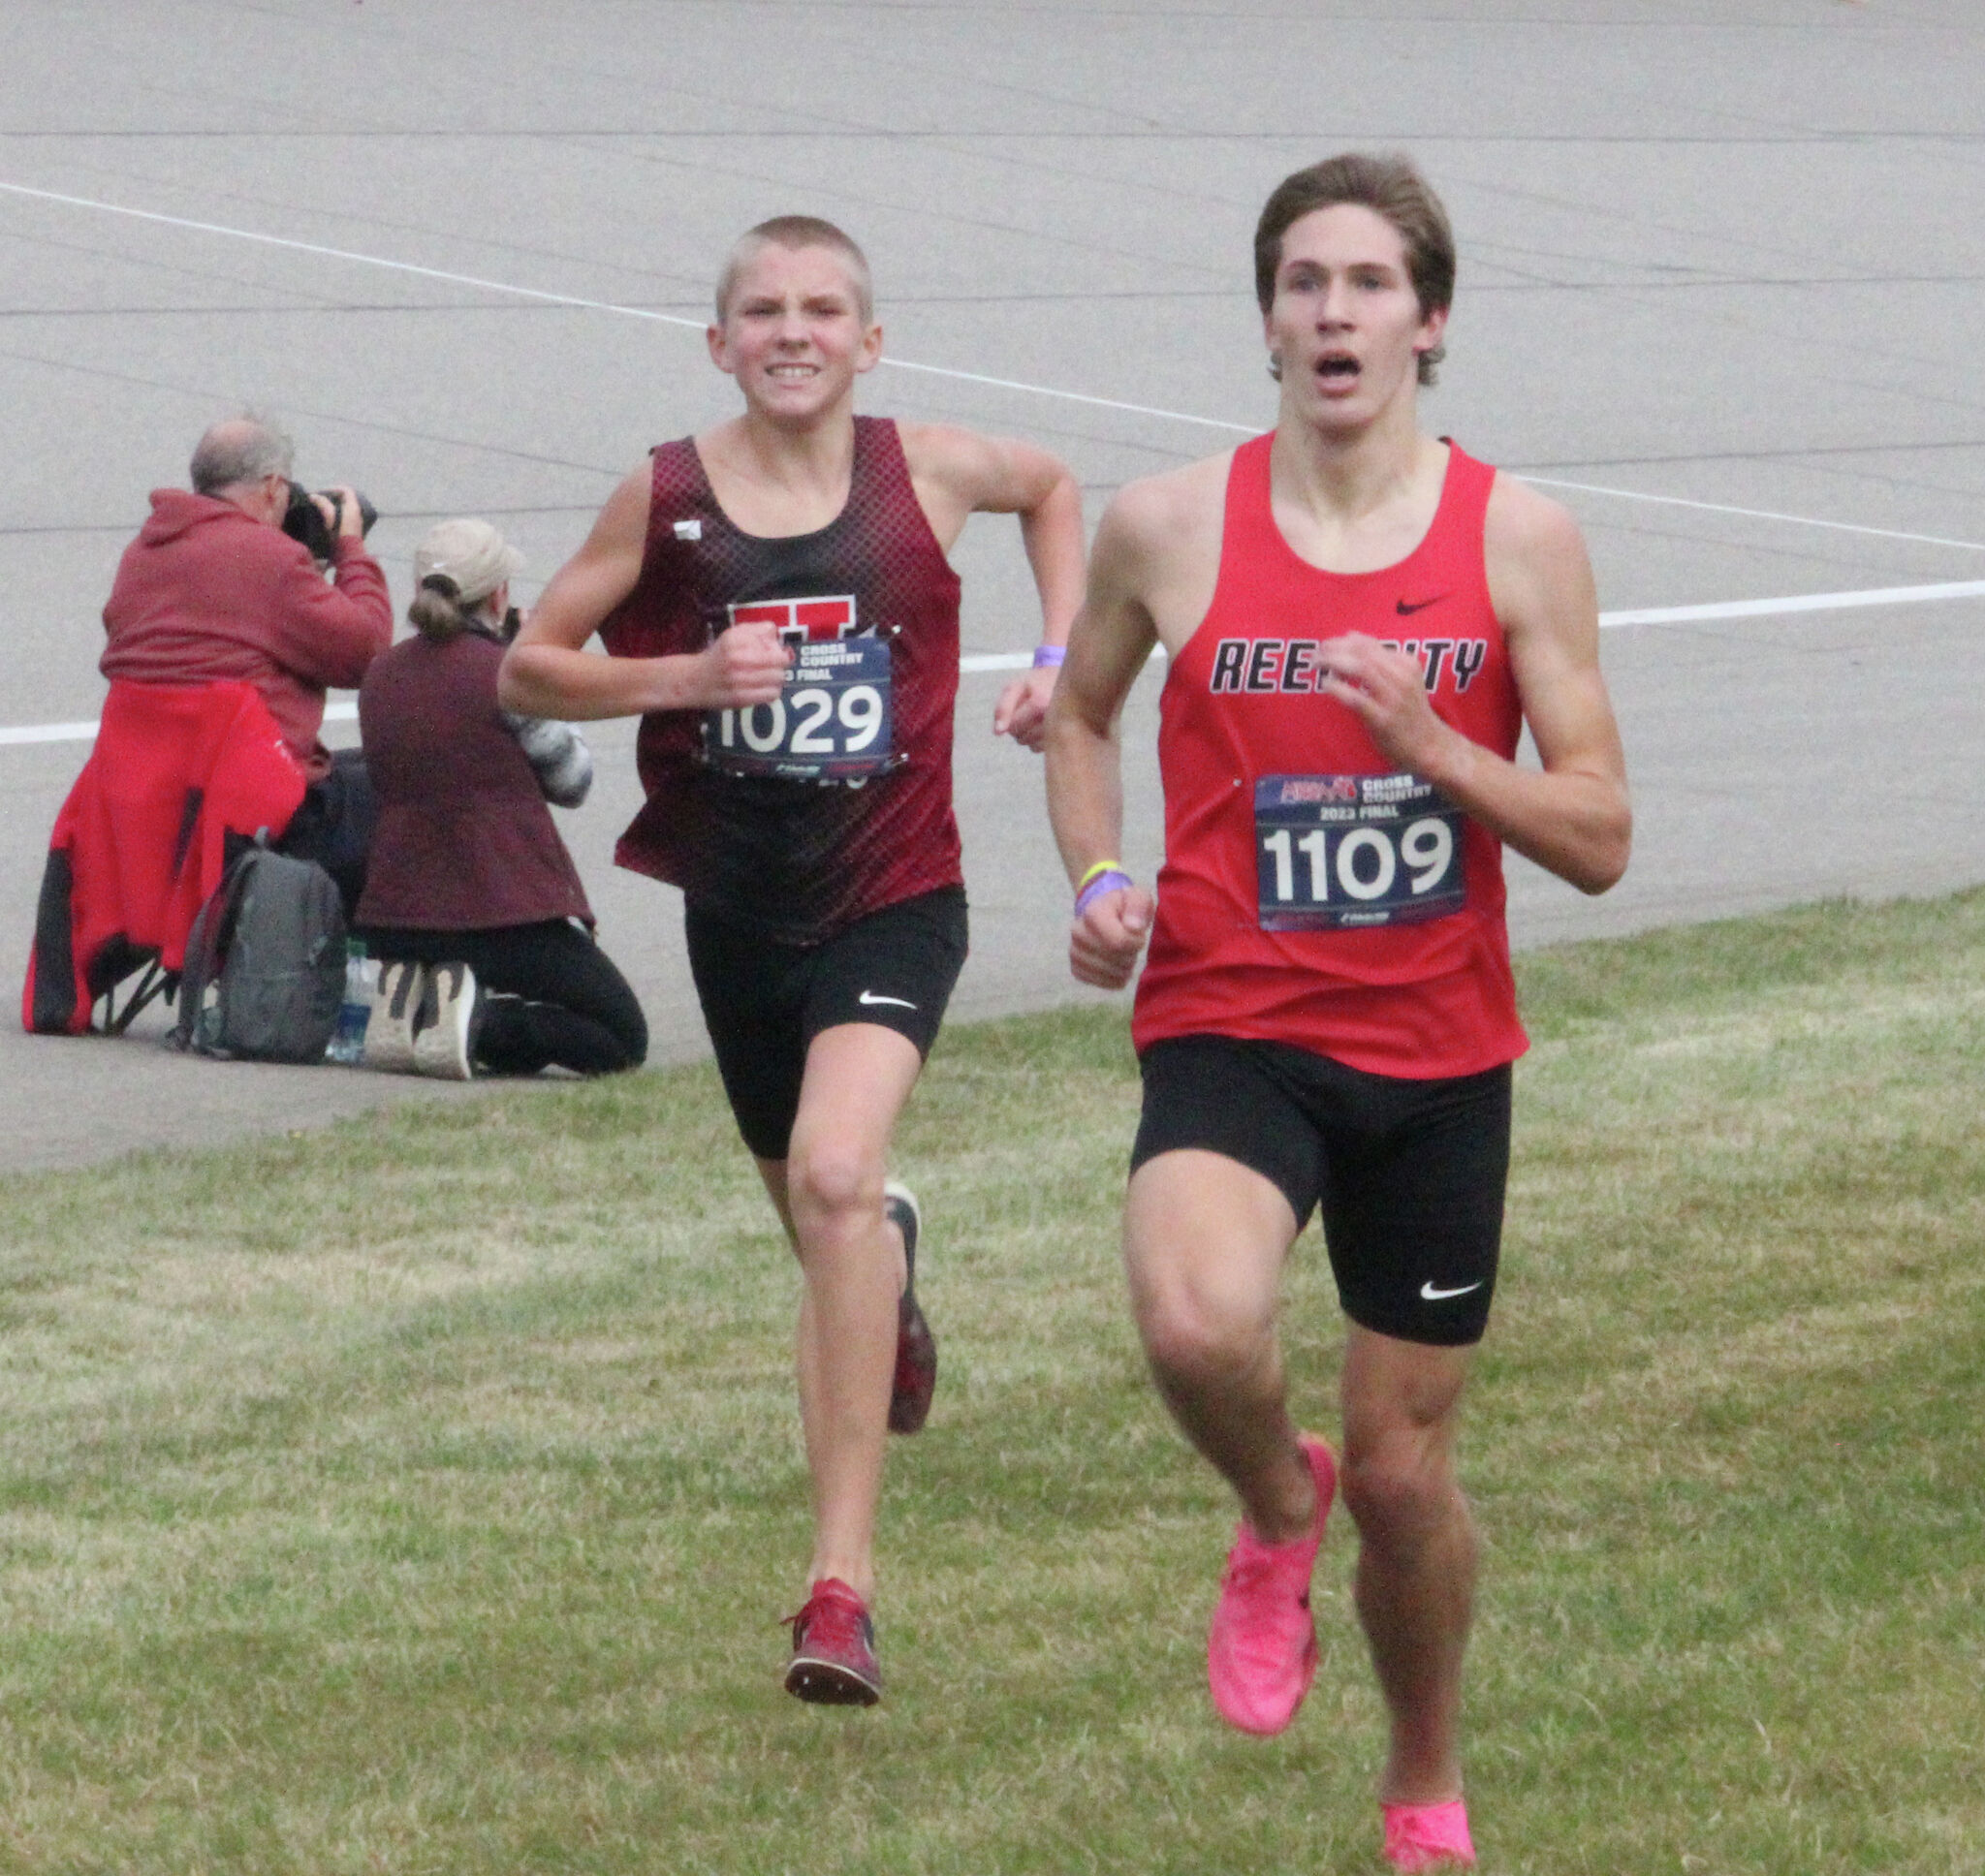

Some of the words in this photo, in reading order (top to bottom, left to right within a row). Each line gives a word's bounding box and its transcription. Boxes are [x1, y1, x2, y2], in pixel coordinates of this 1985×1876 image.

[800, 643, 847, 656] CROSS
[800, 652, 864, 667] COUNTRY
[1378, 638, 1487, 694] TY
[797, 668, 834, 681] FINAL
[721, 685, 883, 753] 1029
[1362, 775, 1413, 792] CROSS
[1362, 784, 1433, 804] COUNTRY
[1320, 806, 1356, 821] 2023
[1359, 804, 1400, 820] FINAL
[1264, 818, 1453, 901] 1109
